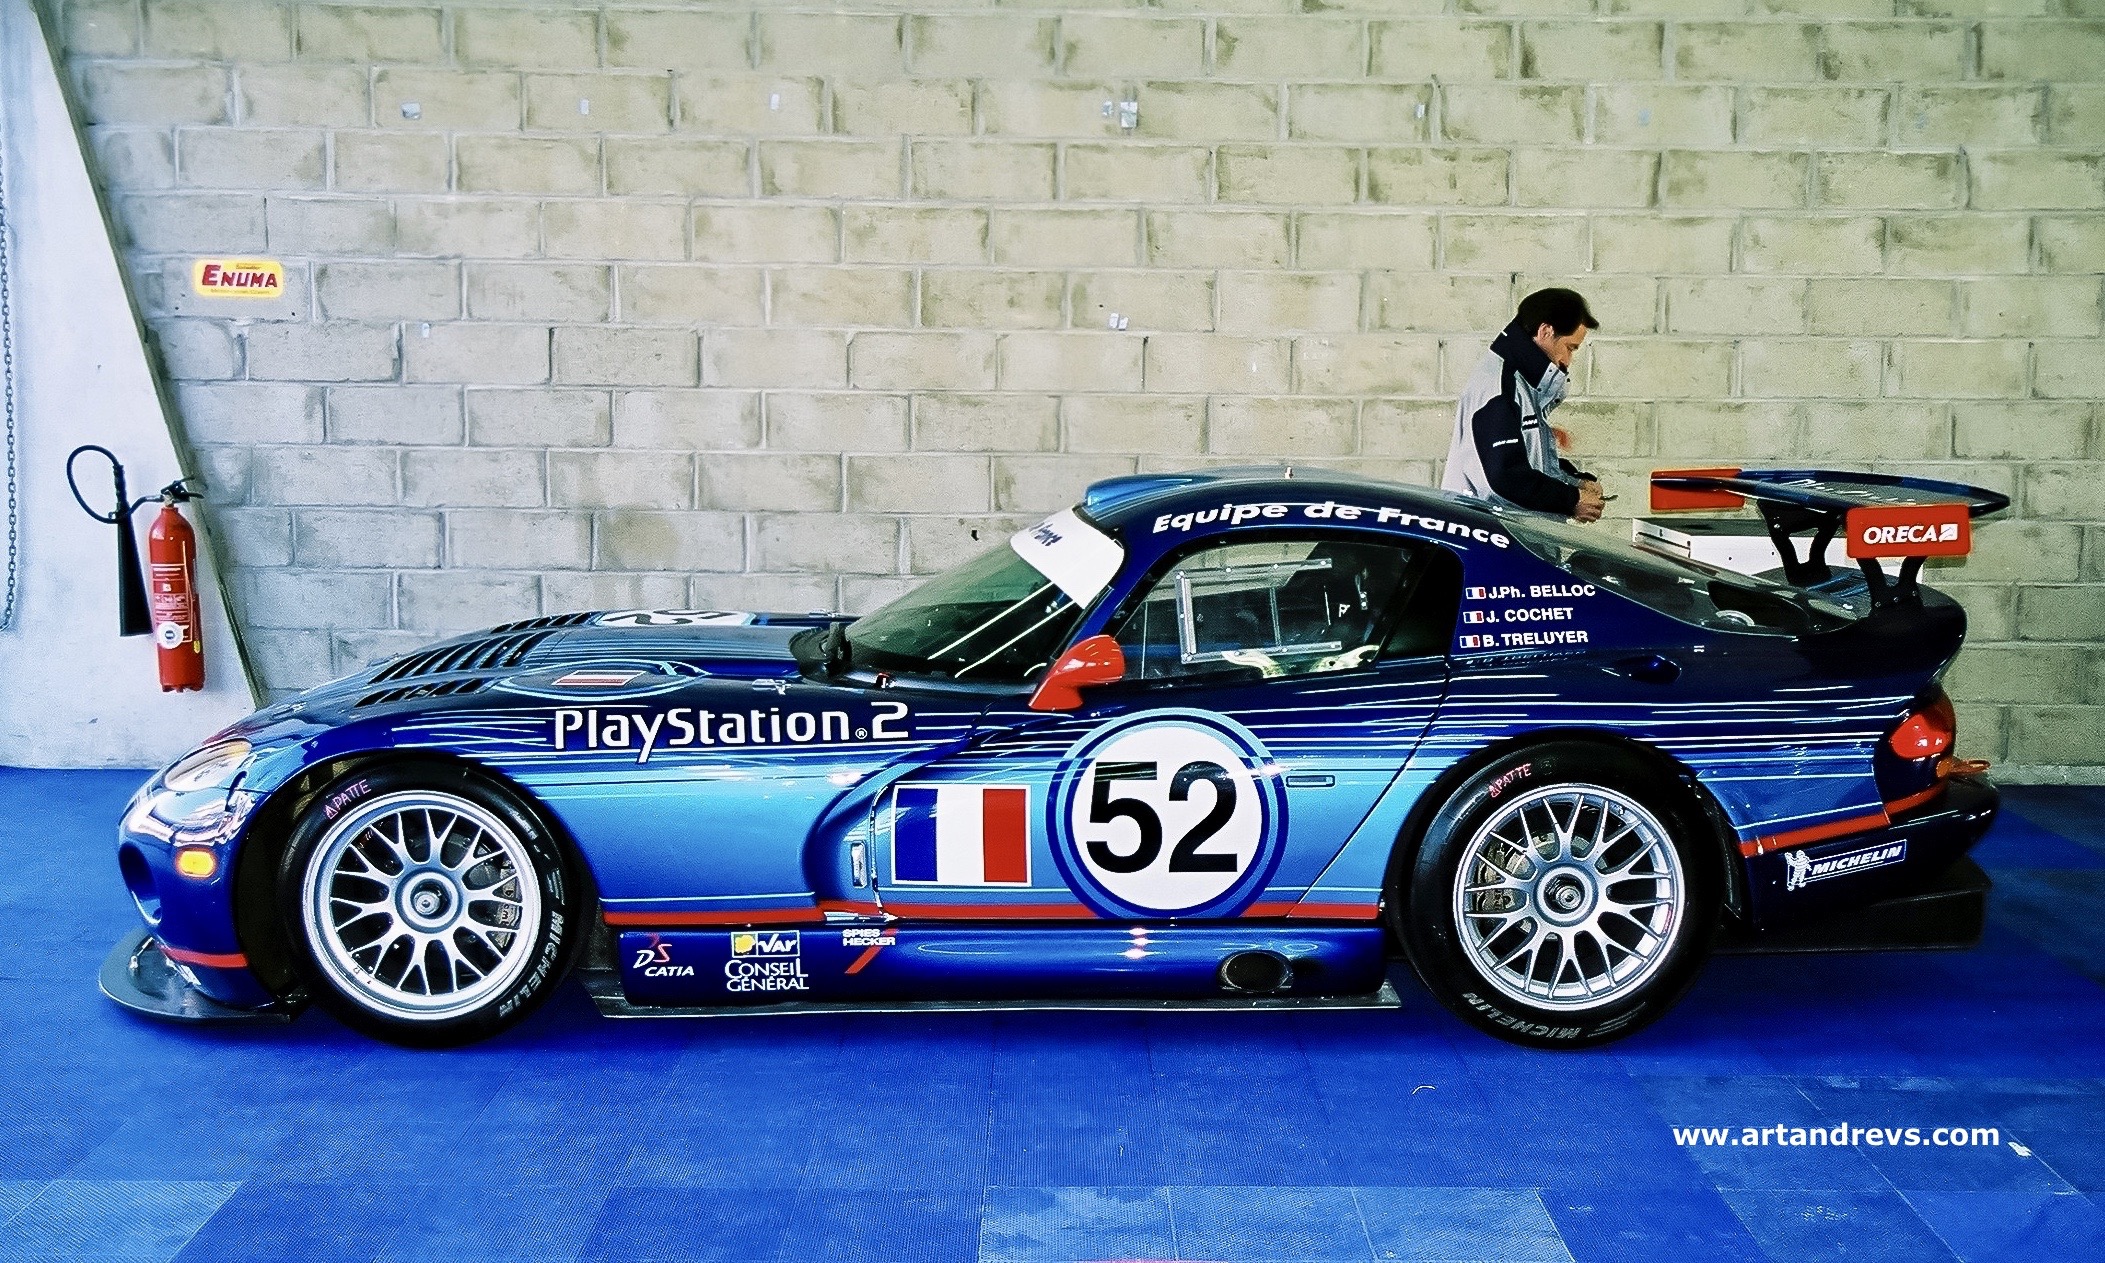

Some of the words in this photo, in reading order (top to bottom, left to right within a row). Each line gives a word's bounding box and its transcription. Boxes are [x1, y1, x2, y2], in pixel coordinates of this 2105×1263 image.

[202, 264, 278, 288] ENUMA
[1152, 503, 1289, 534] Equipe
[1303, 500, 1362, 520] de
[1376, 506, 1511, 549] France
[1863, 524, 1938, 545] ORECA
[1529, 584, 1597, 598] BELLOC
[1486, 610, 1500, 623] J.
[1504, 607, 1574, 622] COCHET
[1482, 634, 1500, 648] B.
[1500, 630, 1589, 647] TRELUYER
[1086, 760, 1238, 874] 52
[1811, 845, 1903, 876] MICHELIN
[842, 936, 896, 946] HECKER
[499, 910, 565, 1018] MICHELIN
[644, 966, 695, 977] CATIA
[724, 958, 809, 979] CONSEIL
[1460, 991, 1582, 1039] MICHELIN
